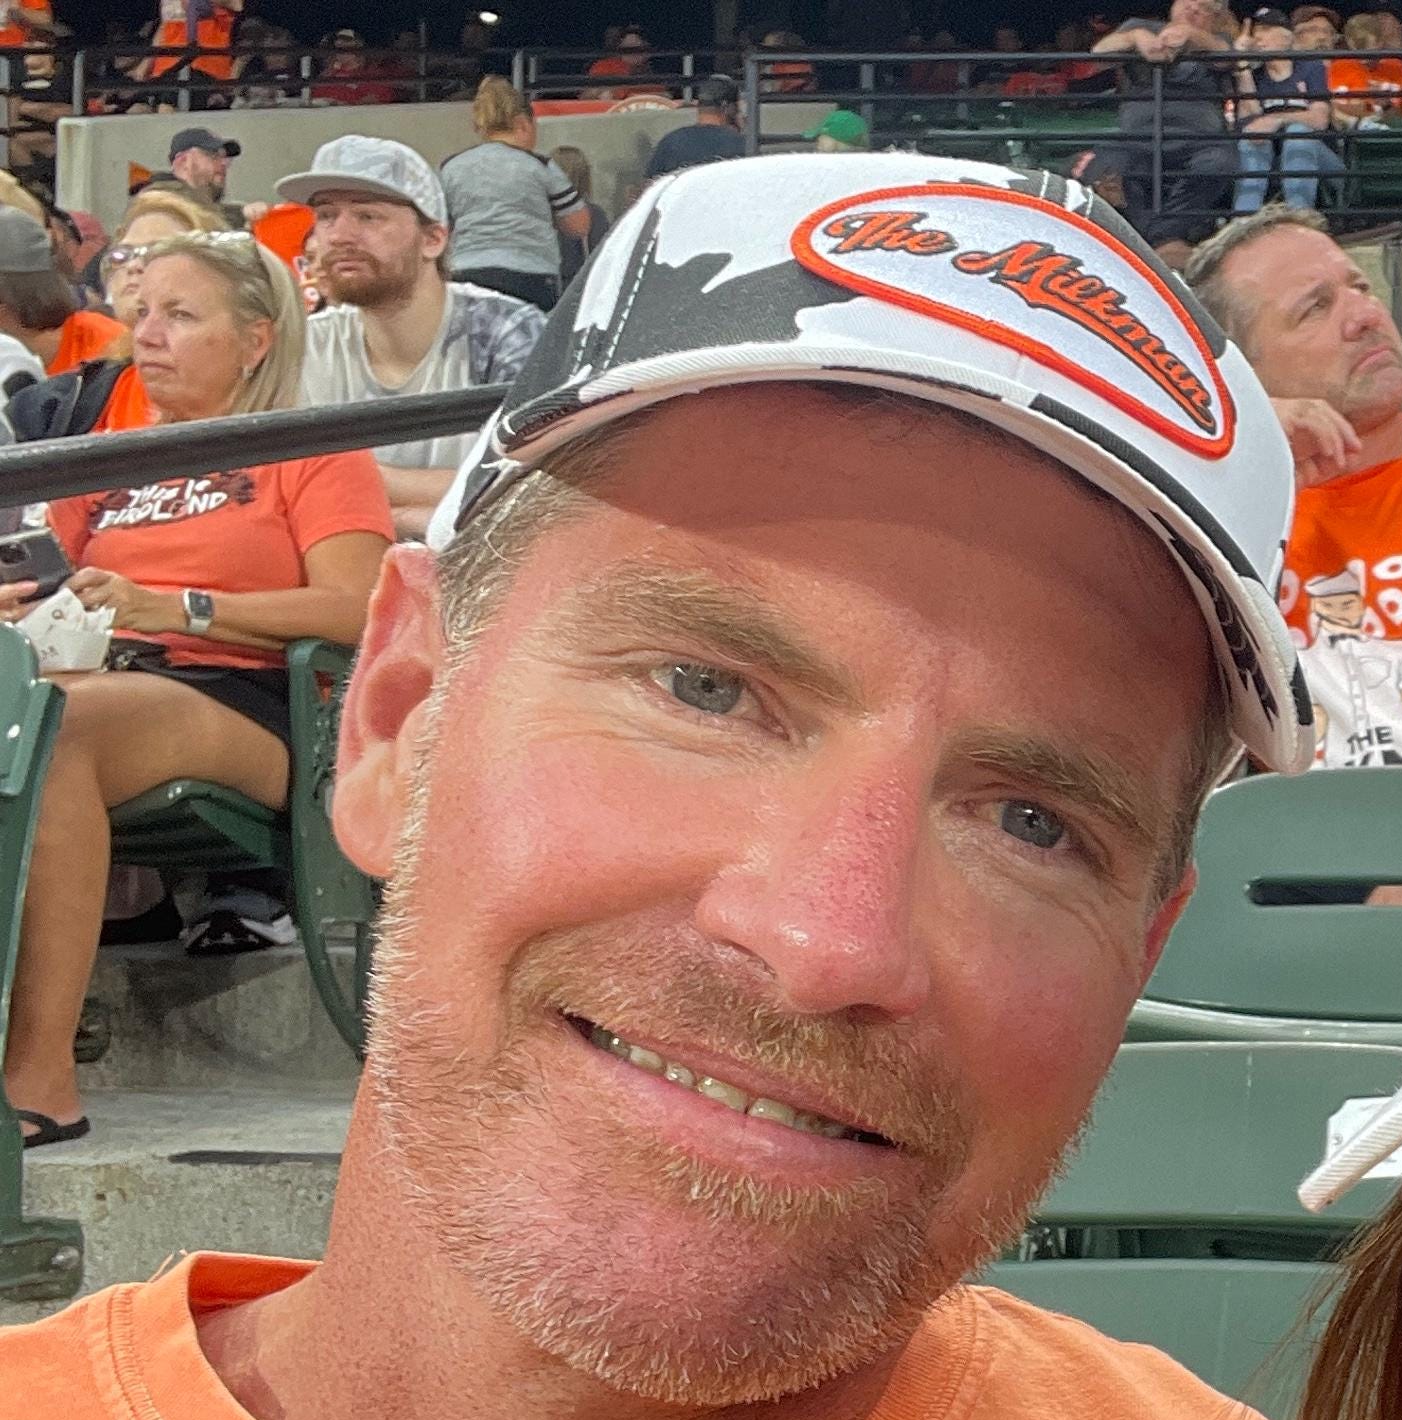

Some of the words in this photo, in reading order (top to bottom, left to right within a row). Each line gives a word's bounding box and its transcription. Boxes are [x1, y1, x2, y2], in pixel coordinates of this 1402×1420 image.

[823, 211, 958, 256] The
[951, 240, 1217, 435] Milkman
[1347, 726, 1394, 755] THE
